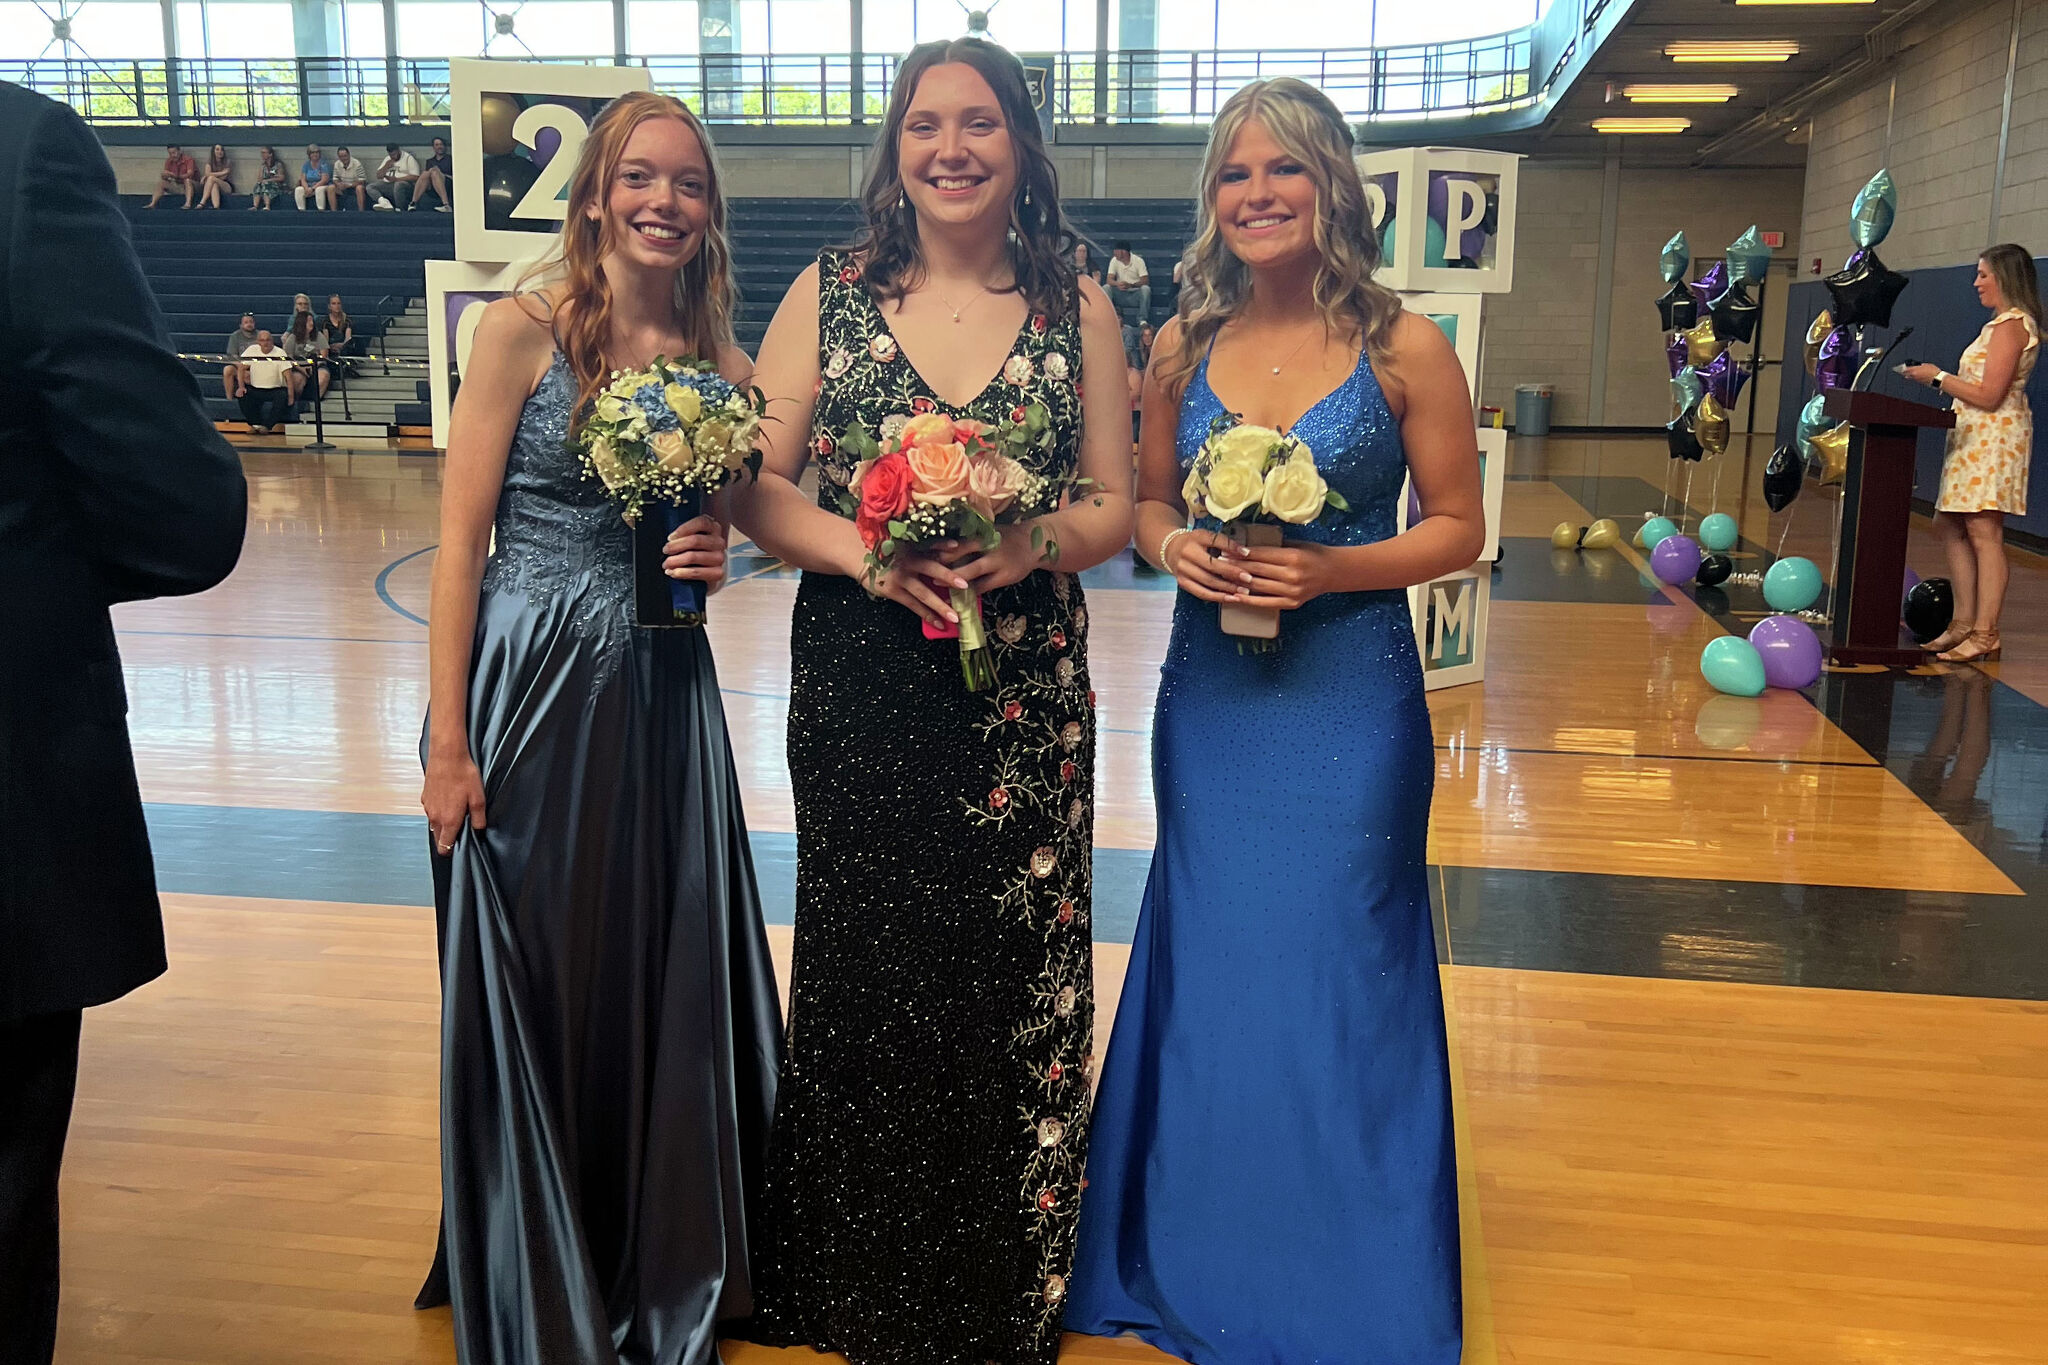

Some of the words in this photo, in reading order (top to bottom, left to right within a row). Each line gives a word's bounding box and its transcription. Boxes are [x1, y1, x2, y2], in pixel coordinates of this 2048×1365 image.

[508, 103, 589, 220] 2
[1442, 179, 1487, 259] P
[1431, 584, 1472, 660] M
